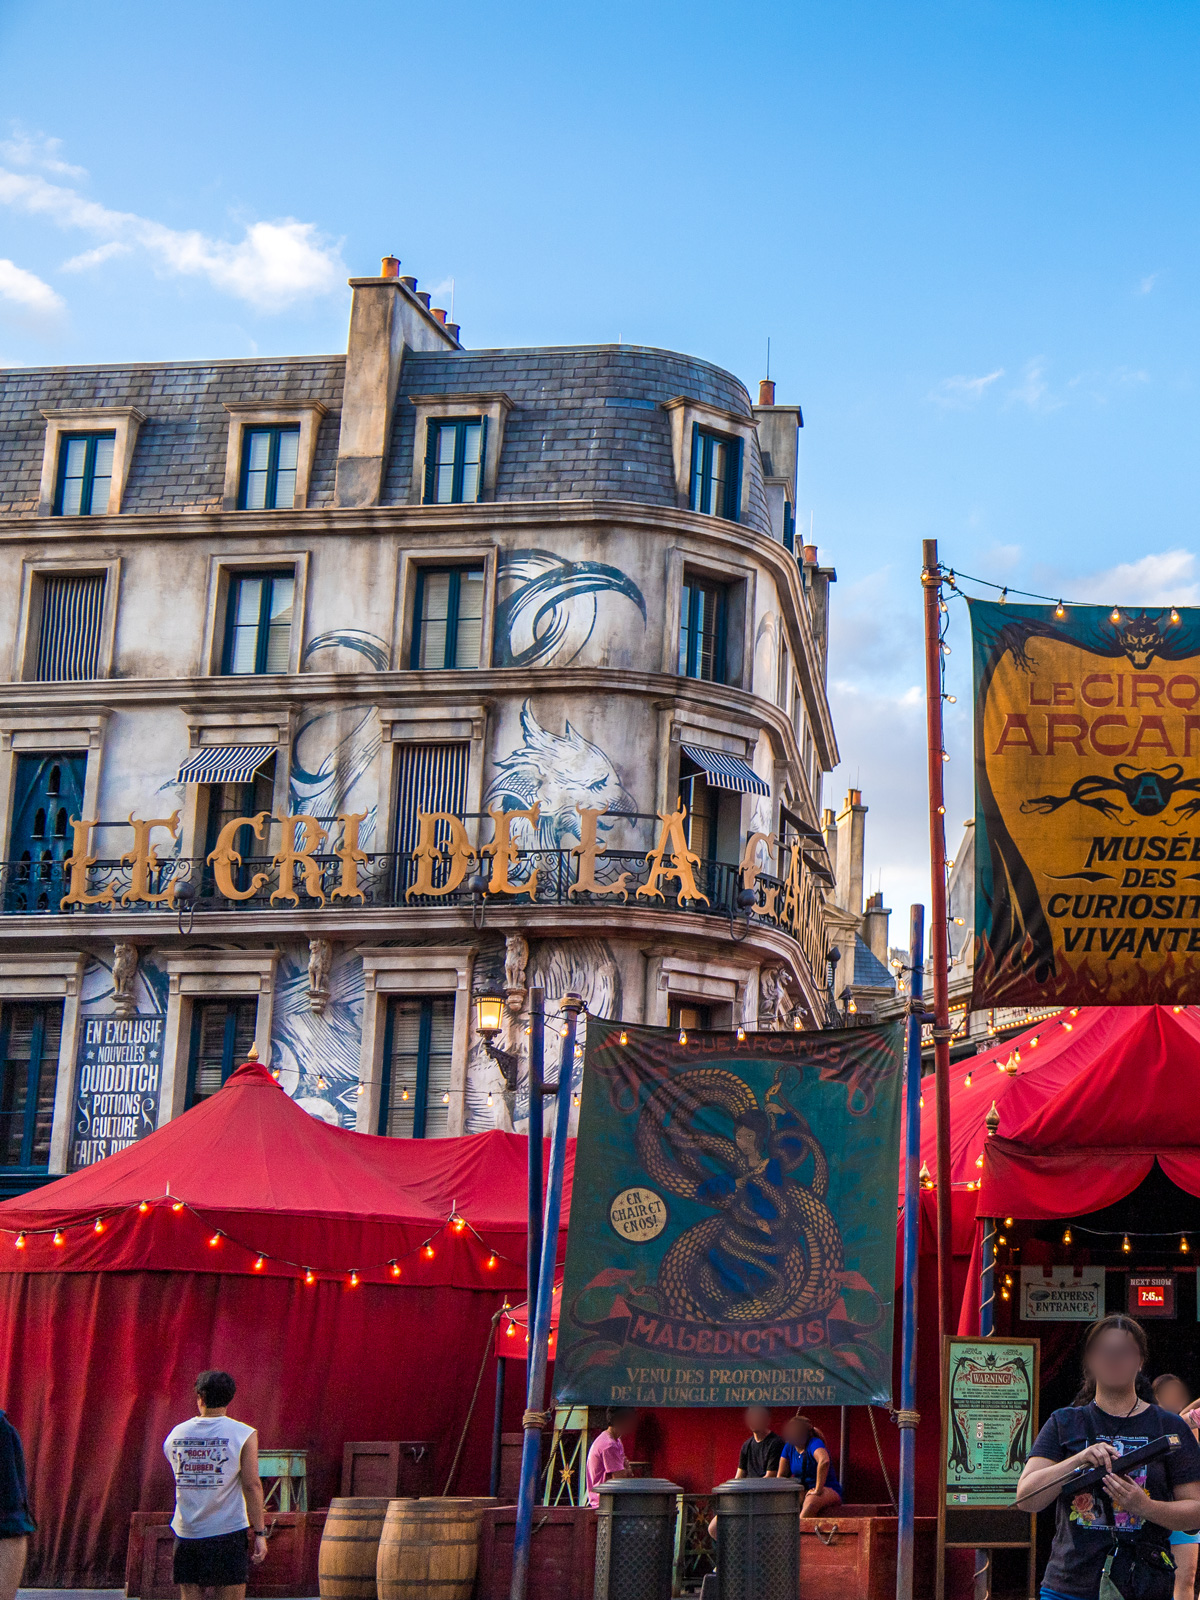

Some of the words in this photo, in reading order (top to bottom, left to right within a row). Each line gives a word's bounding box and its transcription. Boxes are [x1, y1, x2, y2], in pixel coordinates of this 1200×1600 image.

[1029, 682, 1076, 707] LE
[60, 809, 182, 911] LE
[207, 805, 369, 909] CRI
[405, 799, 542, 904] DE
[567, 798, 711, 908] LA
[1120, 868, 1177, 889] DES
[85, 1020, 103, 1044] EN
[105, 1020, 162, 1044] EXCLUSIF
[97, 1045, 145, 1063] NOUVELLES
[733, 1034, 841, 1063] ARCANUS
[80, 1064, 159, 1097] QUIDDITCH
[92, 1094, 141, 1115] POTIONS
[92, 1116, 139, 1138] CULTURE
[73, 1140, 107, 1165] FAITS
[626, 1192, 642, 1205] EN
[612, 1204, 648, 1222] CHAIR
[648, 1200, 662, 1214] ET
[623, 1220, 639, 1234] EN
[639, 1214, 659, 1230] OS!
[1130, 1278, 1150, 1286] NEXT
[1151, 1278, 1172, 1286] SHOW
[1051, 1290, 1095, 1301] EXPRESS
[1036, 1302, 1090, 1312] ENTRANCE
[626, 1367, 671, 1383] VENU
[675, 1368, 705, 1384] DES
[709, 1368, 826, 1384] PROFONDEURS
[973, 1373, 1011, 1384] WARNING!
[611, 1385, 632, 1400] DE
[636, 1385, 657, 1401] LA
[657, 1386, 720, 1404] JUNGLE
[187, 1449, 212, 1457] ROCKY
[184, 1464, 214, 1472] CLUBBER
